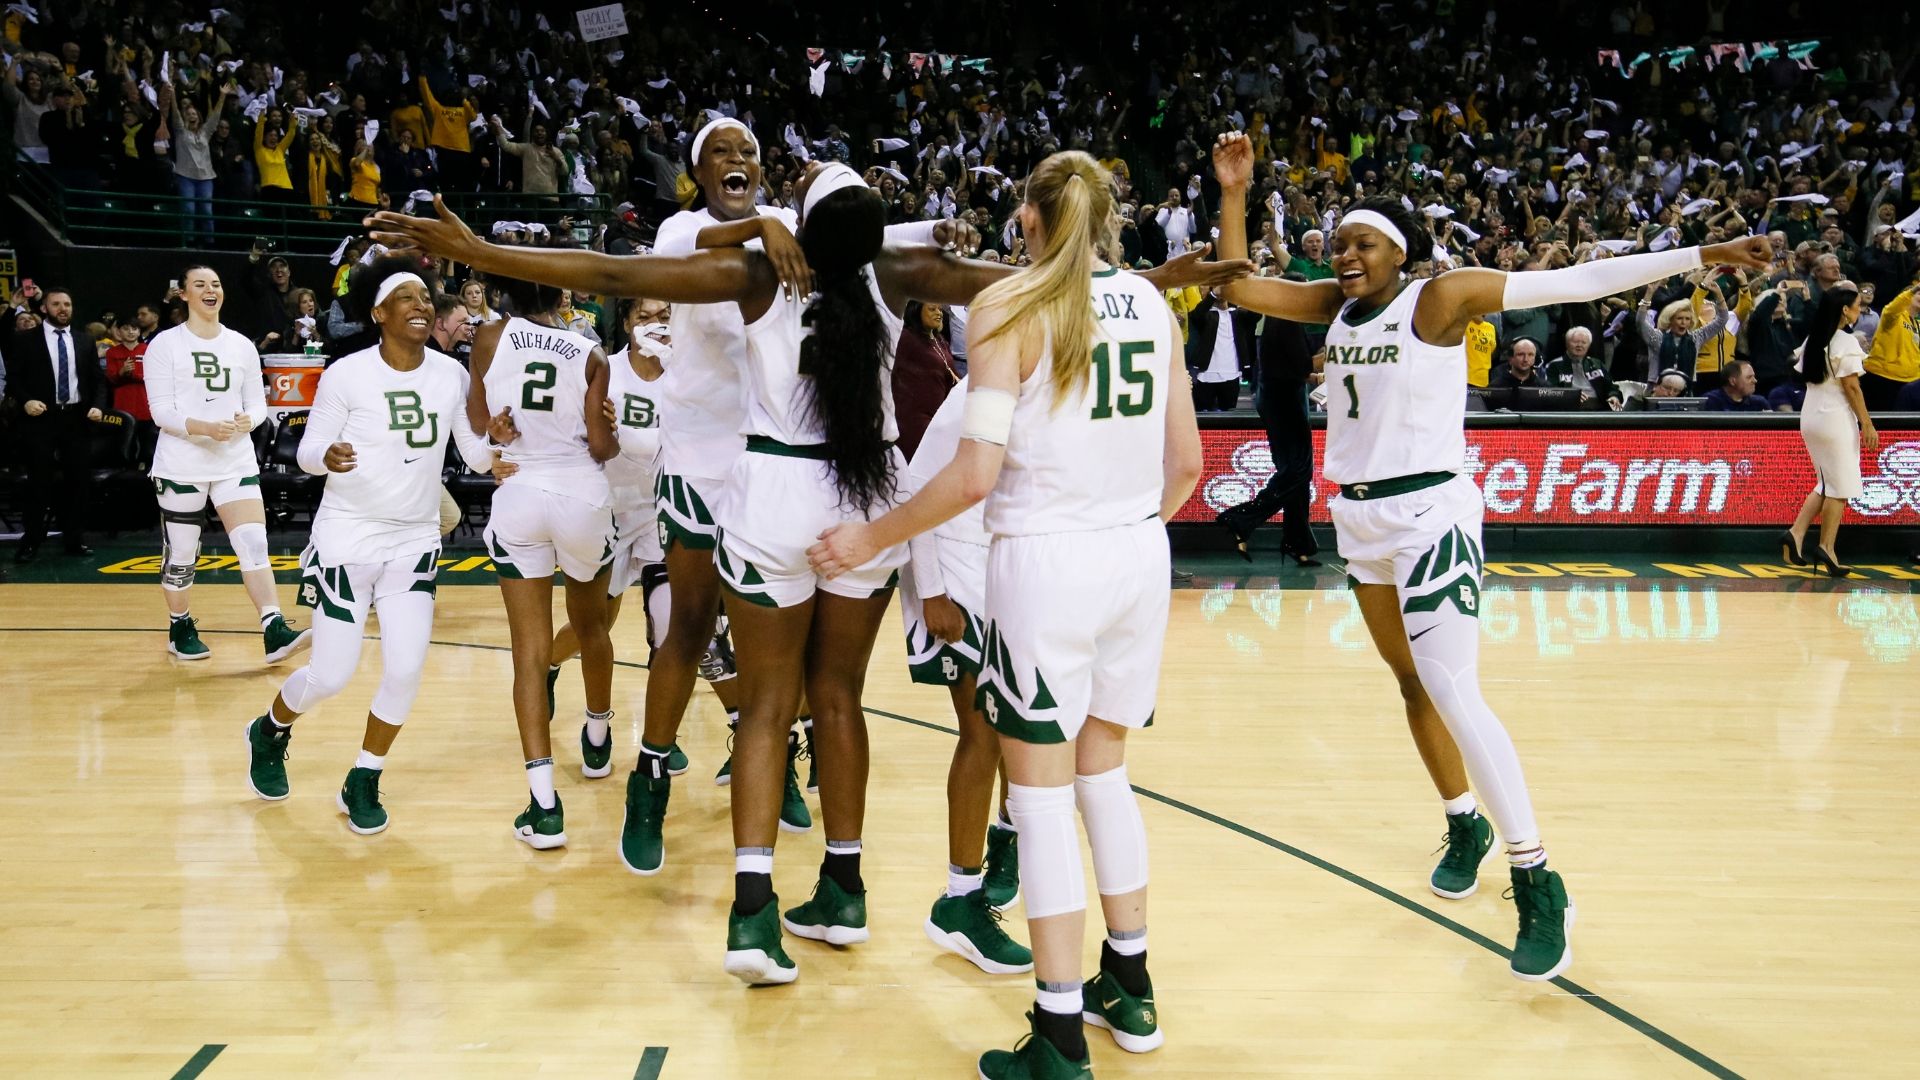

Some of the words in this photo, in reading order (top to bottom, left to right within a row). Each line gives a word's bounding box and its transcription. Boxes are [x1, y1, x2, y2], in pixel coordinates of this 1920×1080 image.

[509, 331, 581, 360] RICHARDS
[1326, 344, 1399, 364] AYLOR
[191, 351, 231, 392] BU
[521, 361, 557, 411] 2
[1091, 340, 1155, 420] 15
[1343, 374, 1359, 419] 1
[103, 414, 123, 426] LOR
[288, 416, 308, 426] BAY
[384, 390, 438, 448] BU
[1482, 562, 1637, 578] 05
[941, 656, 958, 680] BU
